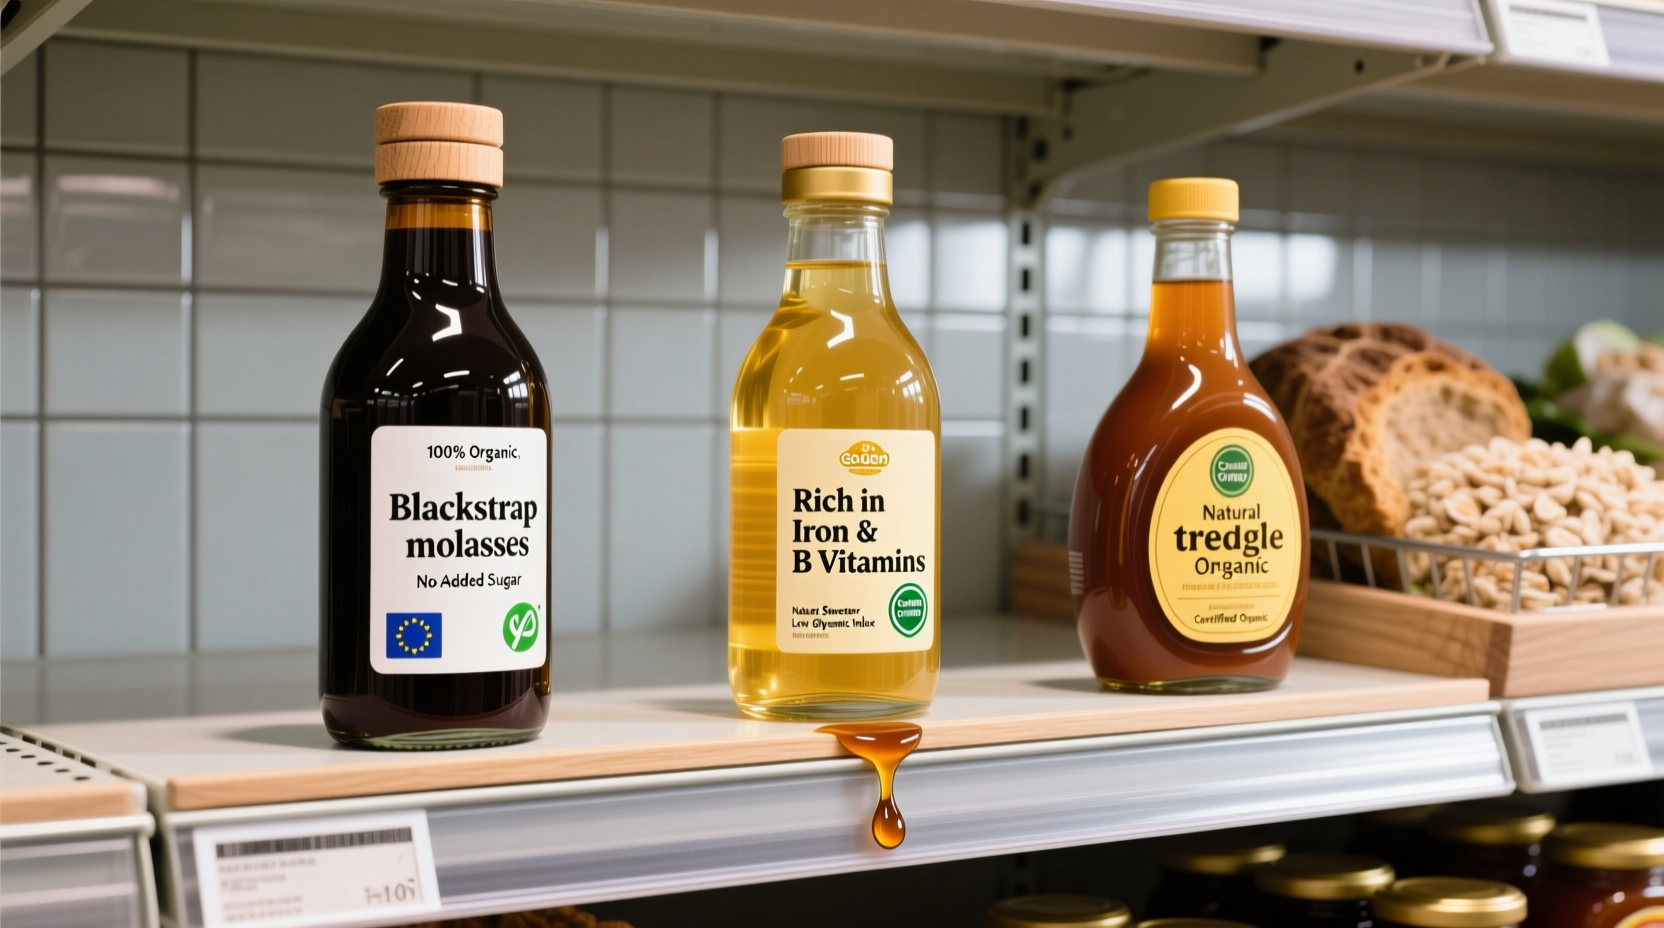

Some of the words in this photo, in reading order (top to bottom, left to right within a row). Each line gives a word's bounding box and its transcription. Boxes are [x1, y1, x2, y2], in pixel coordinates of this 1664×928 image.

[427, 445, 466, 459] 100%
[389, 491, 538, 528] Blackstrap
[793, 487, 854, 513] Rich
[860, 488, 885, 513] in
[1203, 503, 1261, 521] Natural
[406, 528, 530, 558] molasses
[792, 519, 849, 543] Iron
[856, 519, 878, 543] &
[1173, 521, 1284, 558] tredgle
[792, 549, 812, 574] B
[817, 548, 926, 574] Vitamins
[1194, 556, 1270, 580] Organic
[416, 574, 438, 589] No
[440, 572, 485, 588] Added
[487, 572, 522, 590] Sugar
